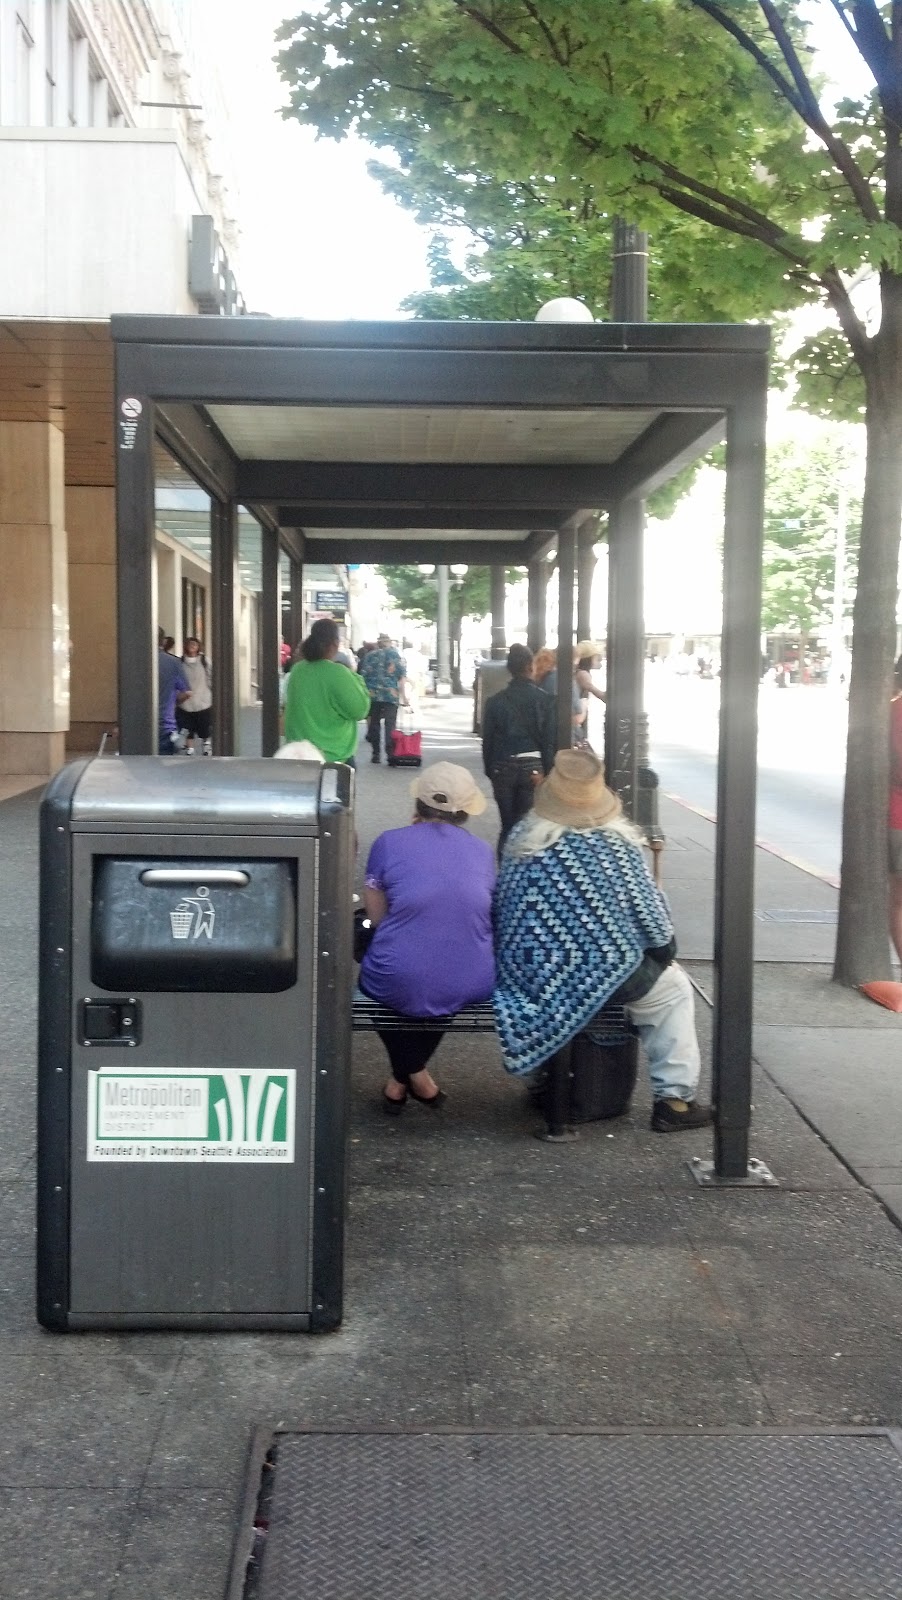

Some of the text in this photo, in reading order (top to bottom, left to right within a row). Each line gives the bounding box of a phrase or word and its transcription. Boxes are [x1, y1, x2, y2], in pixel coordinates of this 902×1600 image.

[105, 1082, 201, 1109] Metropolitan
[104, 1111, 185, 1120] IMPROVEMENT
[104, 1122, 155, 1131] DISTRICT
[94, 1145, 288, 1158] Founded by Downtown Seattle Association
